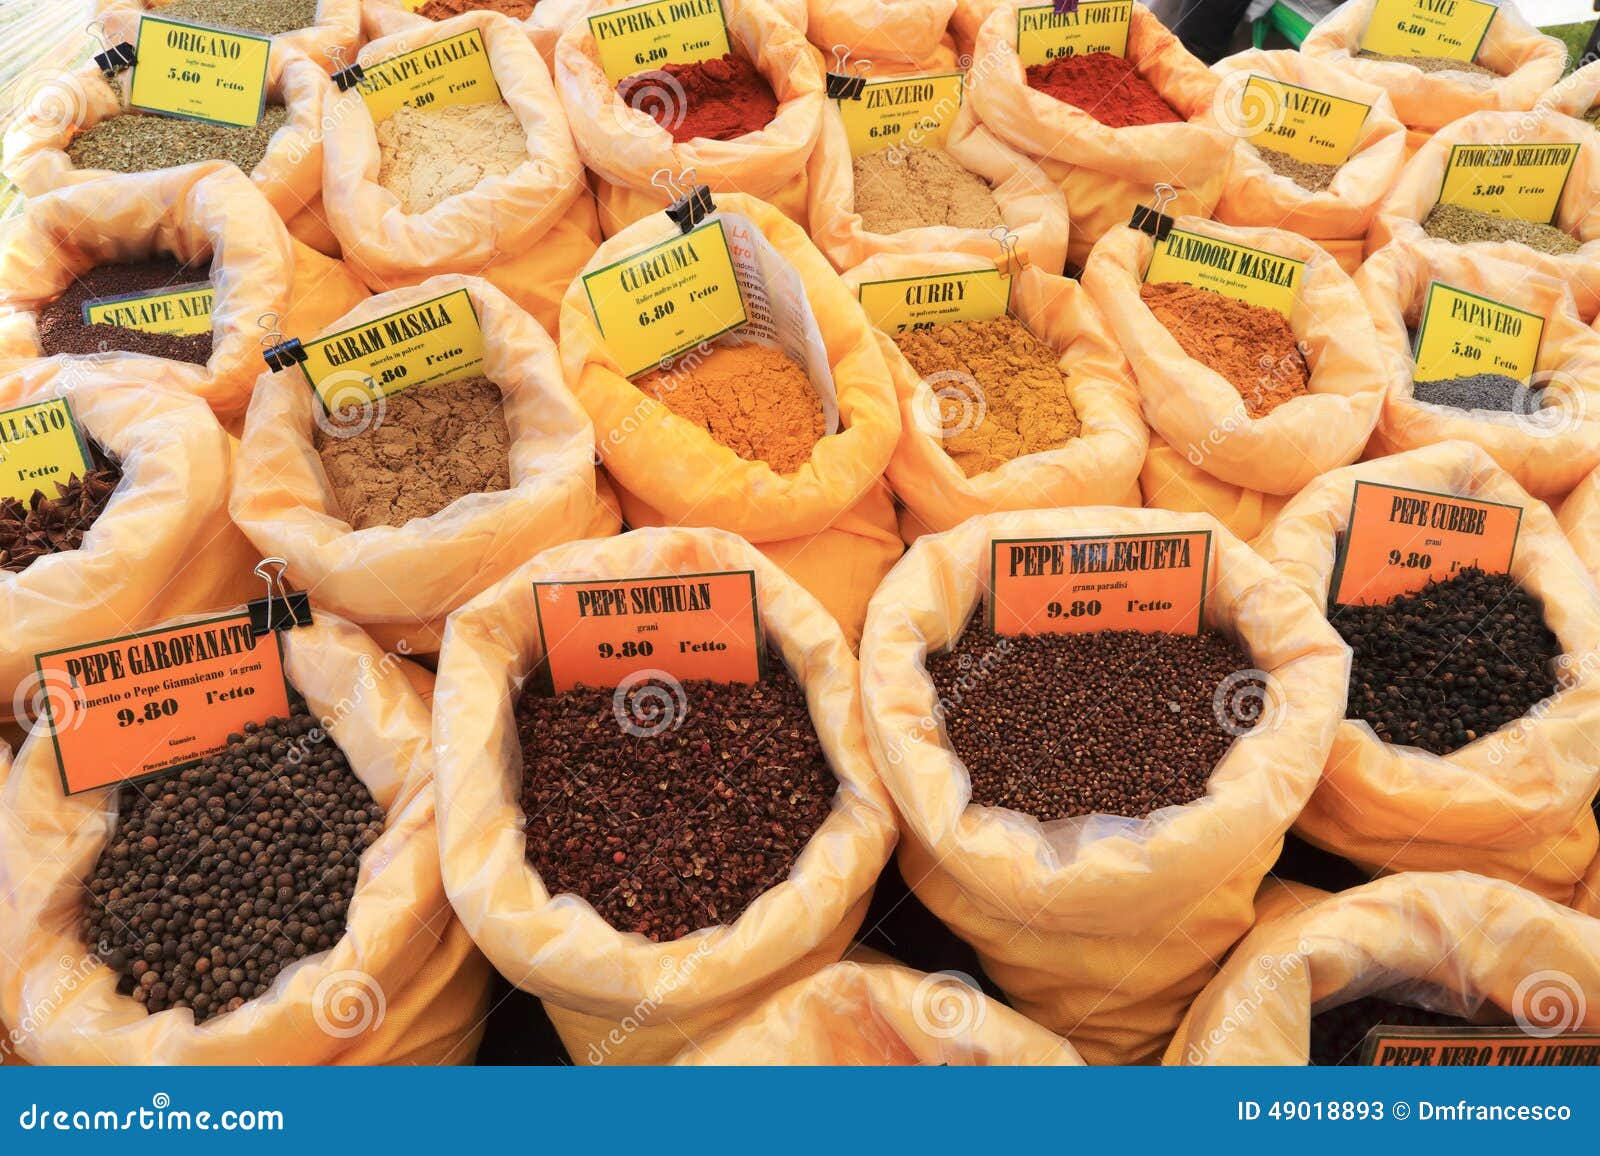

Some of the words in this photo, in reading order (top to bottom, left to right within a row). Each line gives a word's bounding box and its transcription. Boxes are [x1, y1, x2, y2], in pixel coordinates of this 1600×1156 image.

[597, 7, 666, 40] PAPRIKA
[669, 0, 716, 22] DOLCE
[1024, 12, 1080, 31] PAPRIKA
[1085, 6, 1128, 25] FORTE
[1414, 0, 1457, 17] ANICE
[167, 30, 240, 60] ORIGANO
[364, 58, 422, 96] SENAPE
[424, 37, 479, 70] GIALLA
[216, 78, 244, 91] l'etto
[448, 79, 477, 93] l'etto
[867, 84, 934, 109] ZENZERO
[1285, 91, 1331, 118] ANETO
[1513, 148, 1571, 167] SELVATICO
[620, 242, 700, 292] CURCUMA
[1166, 234, 1237, 273] TANDOORI
[1236, 252, 1295, 288] MASALA
[689, 284, 719, 302] l'etto
[906, 280, 968, 306] CURRY
[104, 301, 175, 328] SENAPE
[1452, 298, 1522, 338] PAPAVERO
[324, 328, 386, 366] GARAM
[384, 304, 452, 345] MASALA
[426, 348, 463, 366] l'etto
[1494, 356, 1518, 371] l'etto
[18, 466, 59, 480] l'etto
[1389, 496, 1430, 526] PEPE
[1431, 502, 1487, 536] CUBEBE
[1009, 544, 1064, 577] PEPE
[1070, 538, 1191, 574] MELEGUETA
[1097, 582, 1128, 592] paradisi
[576, 589, 628, 617] PEPE
[630, 583, 711, 615] SICHUAN
[1128, 600, 1172, 612] l'etto
[637, 624, 658, 633] grani
[65, 650, 126, 688] PEPE
[128, 623, 257, 675] GAROFANATO
[679, 640, 727, 653] l'etto
[74, 693, 121, 712] Pimento
[124, 691, 131, 700] o
[134, 684, 160, 699] Pepe
[162, 670, 224, 690] Giamaicano
[229, 667, 238, 676] in
[240, 662, 262, 676] grani
[206, 686, 256, 705] l'etto
[1380, 1046, 1436, 1066] PEPE
[1438, 1046, 1493, 1066] NERO
